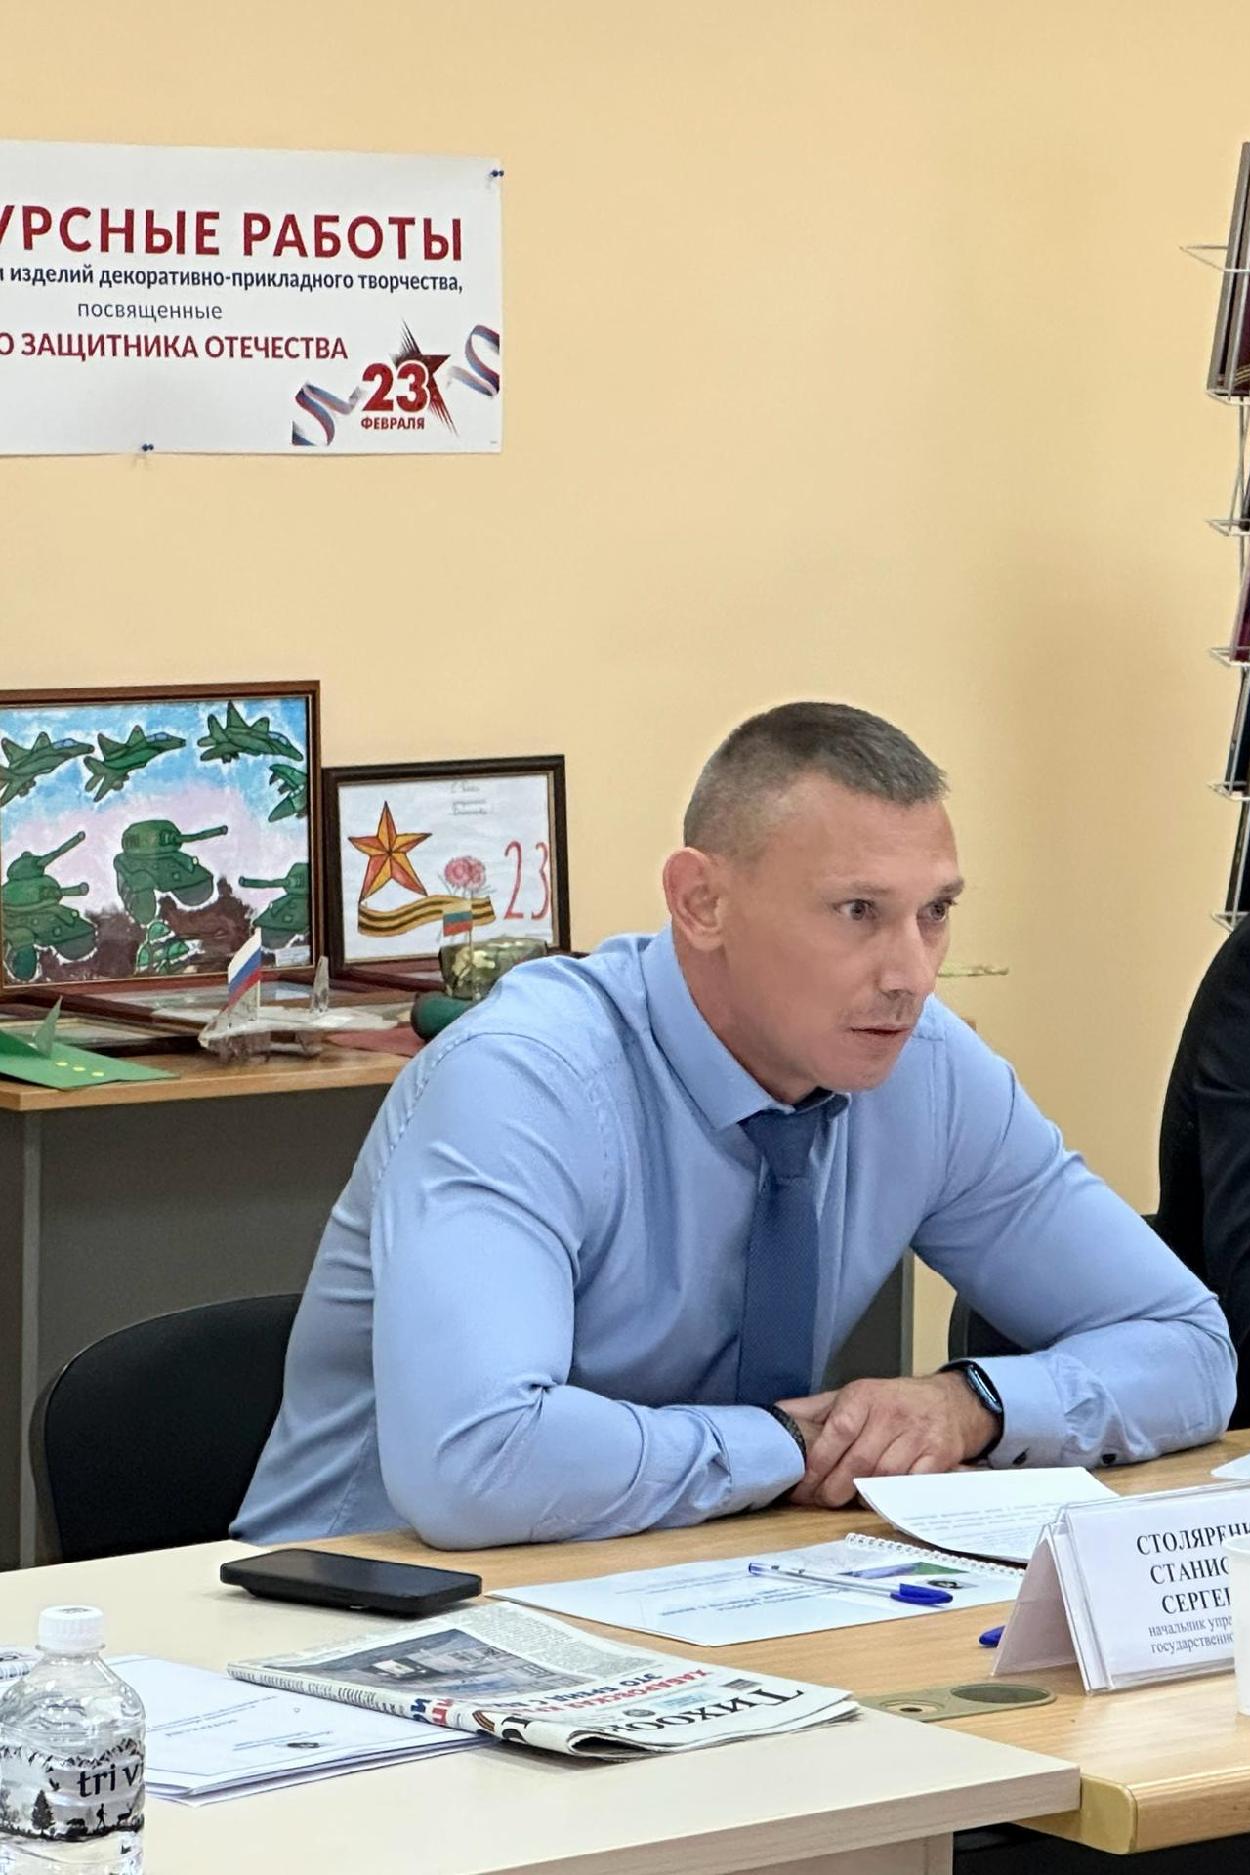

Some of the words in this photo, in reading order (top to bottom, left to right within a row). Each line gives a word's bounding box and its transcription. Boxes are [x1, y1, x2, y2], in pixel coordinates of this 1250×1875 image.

[243, 212, 462, 262] РАБОТЫ
[10, 264, 94, 288] изделий
[99, 269, 354, 292] декоративно-прикладного
[358, 275, 463, 294] творчества,
[77, 303, 223, 322] посвященные
[21, 332, 199, 362] ЗАЩИТНИКА
[204, 335, 348, 359] ОТЕЧЕСТВА
[362, 362, 428, 413] 23
[361, 417, 425, 430] ФЕВРАЛЯ
[504, 840, 550, 920] 23
[1148, 1619, 1206, 1637] начальник
[77, 1763, 116, 1798] tri
